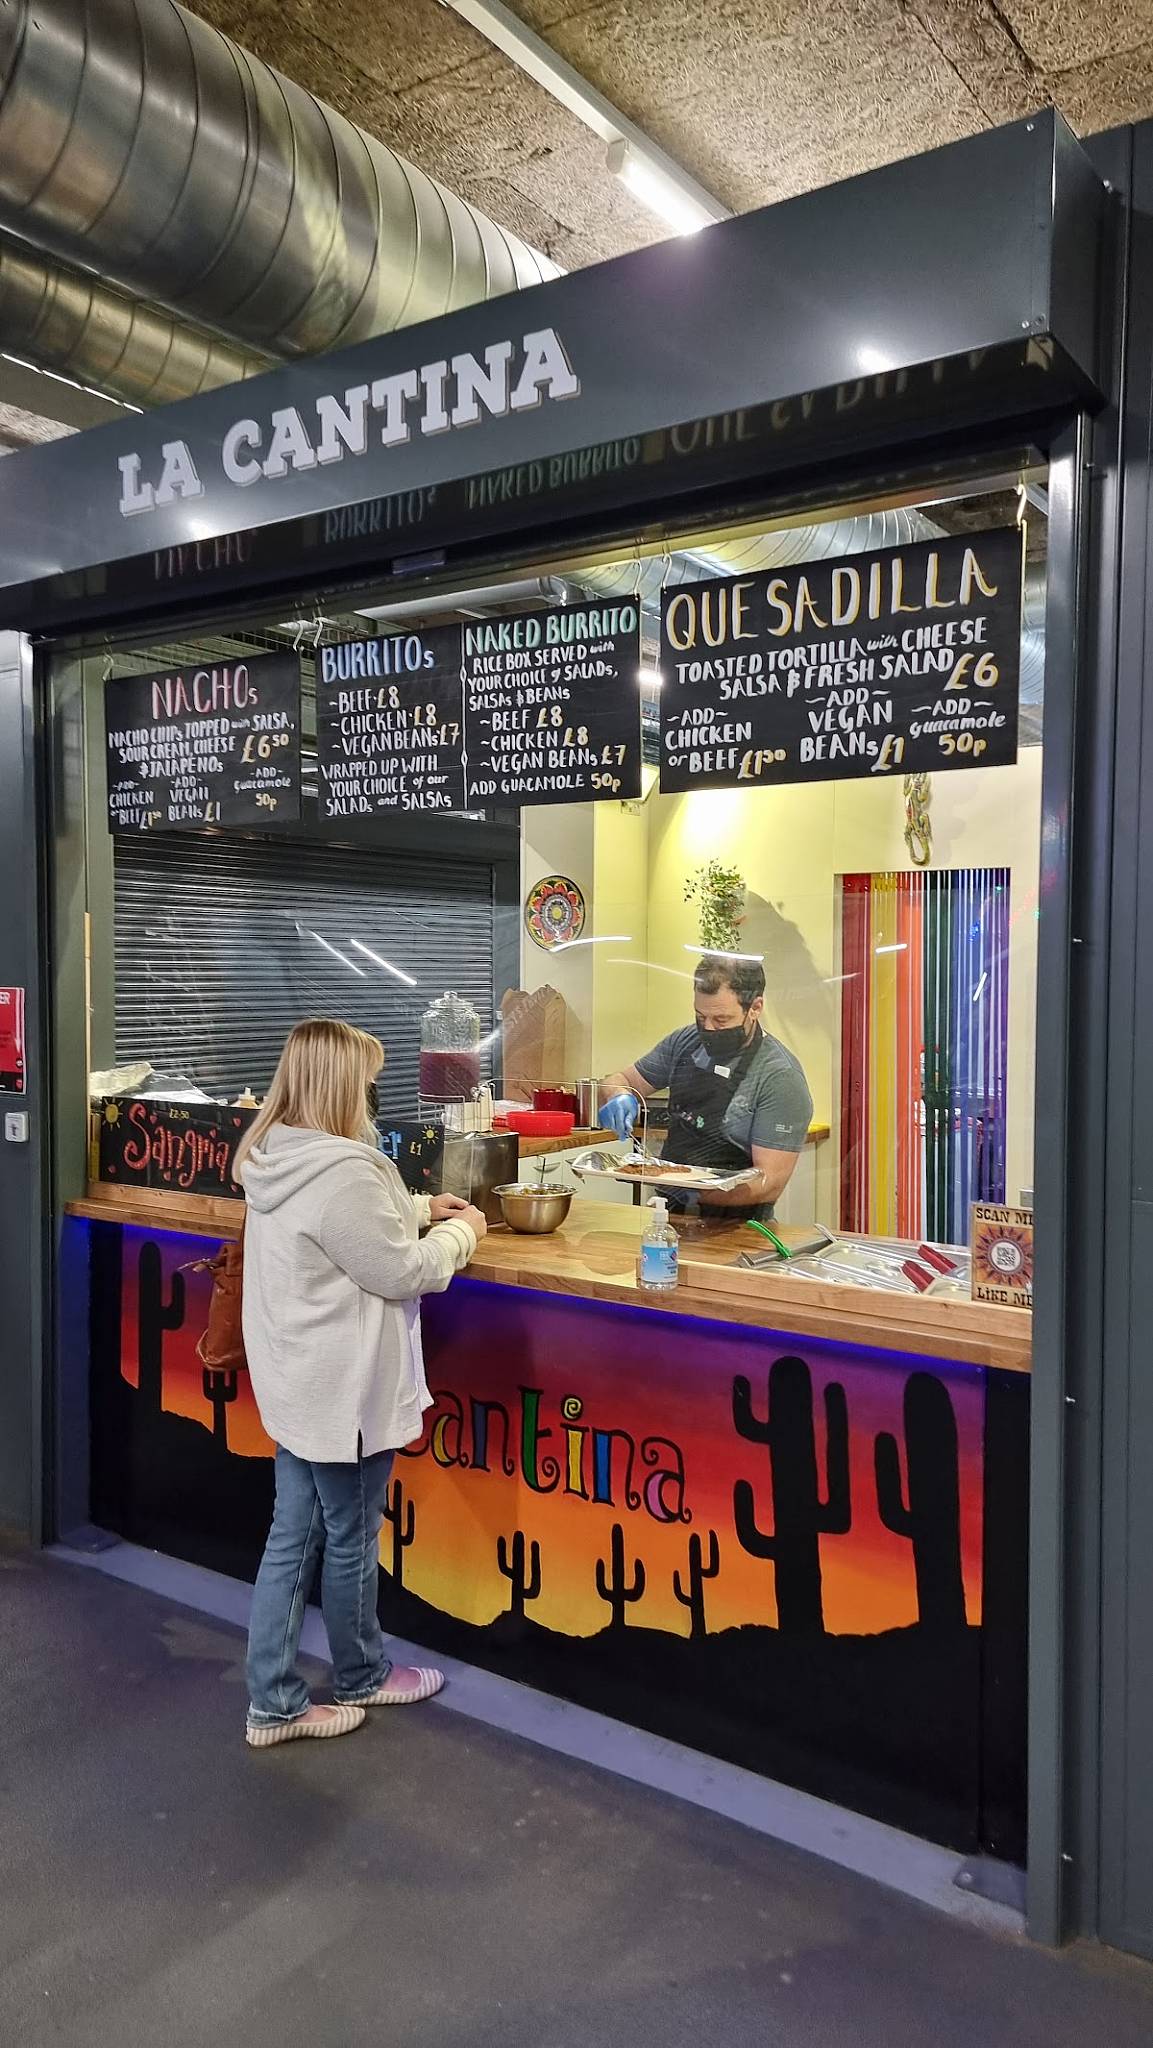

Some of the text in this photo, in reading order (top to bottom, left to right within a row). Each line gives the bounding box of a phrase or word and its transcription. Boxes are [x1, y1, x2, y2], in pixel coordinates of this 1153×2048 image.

[118, 439, 204, 516] LA
[221, 327, 581, 486] CANTINA
[466, 606, 637, 656] NAKED BURRITO
[473, 641, 615, 675] RICE BOX SERVED with
[675, 616, 988, 685] TOASTED TORTILLA with CHEESE
[468, 677, 502, 694] YOUR
[505, 669, 546, 689] CHOICE
[720, 675, 781, 701] SALSA
[804, 658, 874, 689] FRESH
[879, 648, 954, 680] SALAD
[943, 652, 999, 691] £6
[376, 686, 400, 709] £8
[414, 704, 436, 726] £8
[536, 705, 563, 728] £8
[807, 701, 893, 734] VEGAN
[109, 728, 149, 748] NACHO
[185, 717, 230, 738] TOPPED
[439, 723, 460, 746] £7
[563, 726, 589, 747] £8
[665, 722, 752, 750] CHICKEN
[939, 731, 987, 758] 50p
[119, 747, 149, 764] SOUR
[194, 736, 236, 754] CHEESE
[601, 744, 627, 766] £7
[668, 753, 687, 766] or
[689, 748, 739, 774] BEEF
[871, 733, 905, 772] £1
[321, 754, 438, 780] WRAPPED UP WITH
[170, 787, 209, 803] VEGAN
[330, 775, 449, 798] YOUR CHOICE of our
[469, 772, 621, 796] ADD GUACAMOLE 50p
[110, 791, 154, 807] CHICKEN
[256, 793, 277, 811] 50p
[377, 795, 399, 806] and
[119, 809, 139, 825] BEEF
[204, 802, 221, 822] £1
[124, 1103, 228, 1188] Sangria
[410, 1141, 422, 1157] £1
[977, 1208, 1010, 1223] SCAN
[396, 1385, 692, 1523] antina
